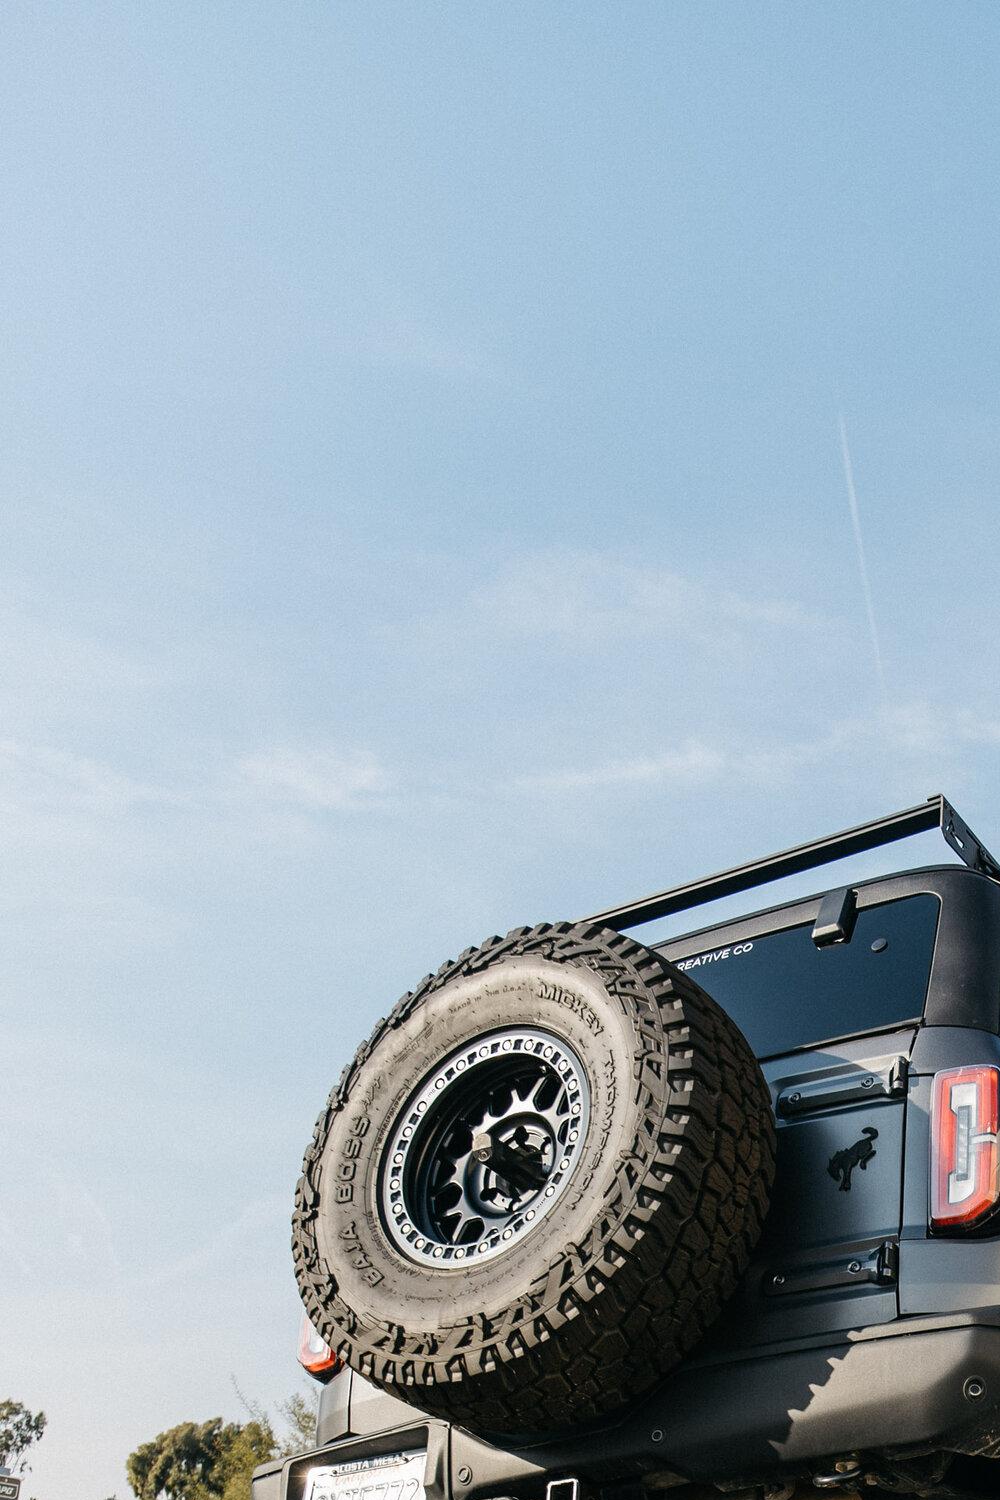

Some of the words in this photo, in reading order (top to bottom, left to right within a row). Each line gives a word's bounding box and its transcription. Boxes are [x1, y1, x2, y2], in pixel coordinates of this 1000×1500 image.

[733, 942, 753, 956] CO
[536, 981, 605, 1037] MICKEY
[335, 1115, 371, 1204] BOSS
[566, 1049, 617, 1211] THOMPSON
[339, 1221, 386, 1288] BAJA
[340, 1459, 370, 1473] COSTA
[373, 1454, 401, 1467] MESA
